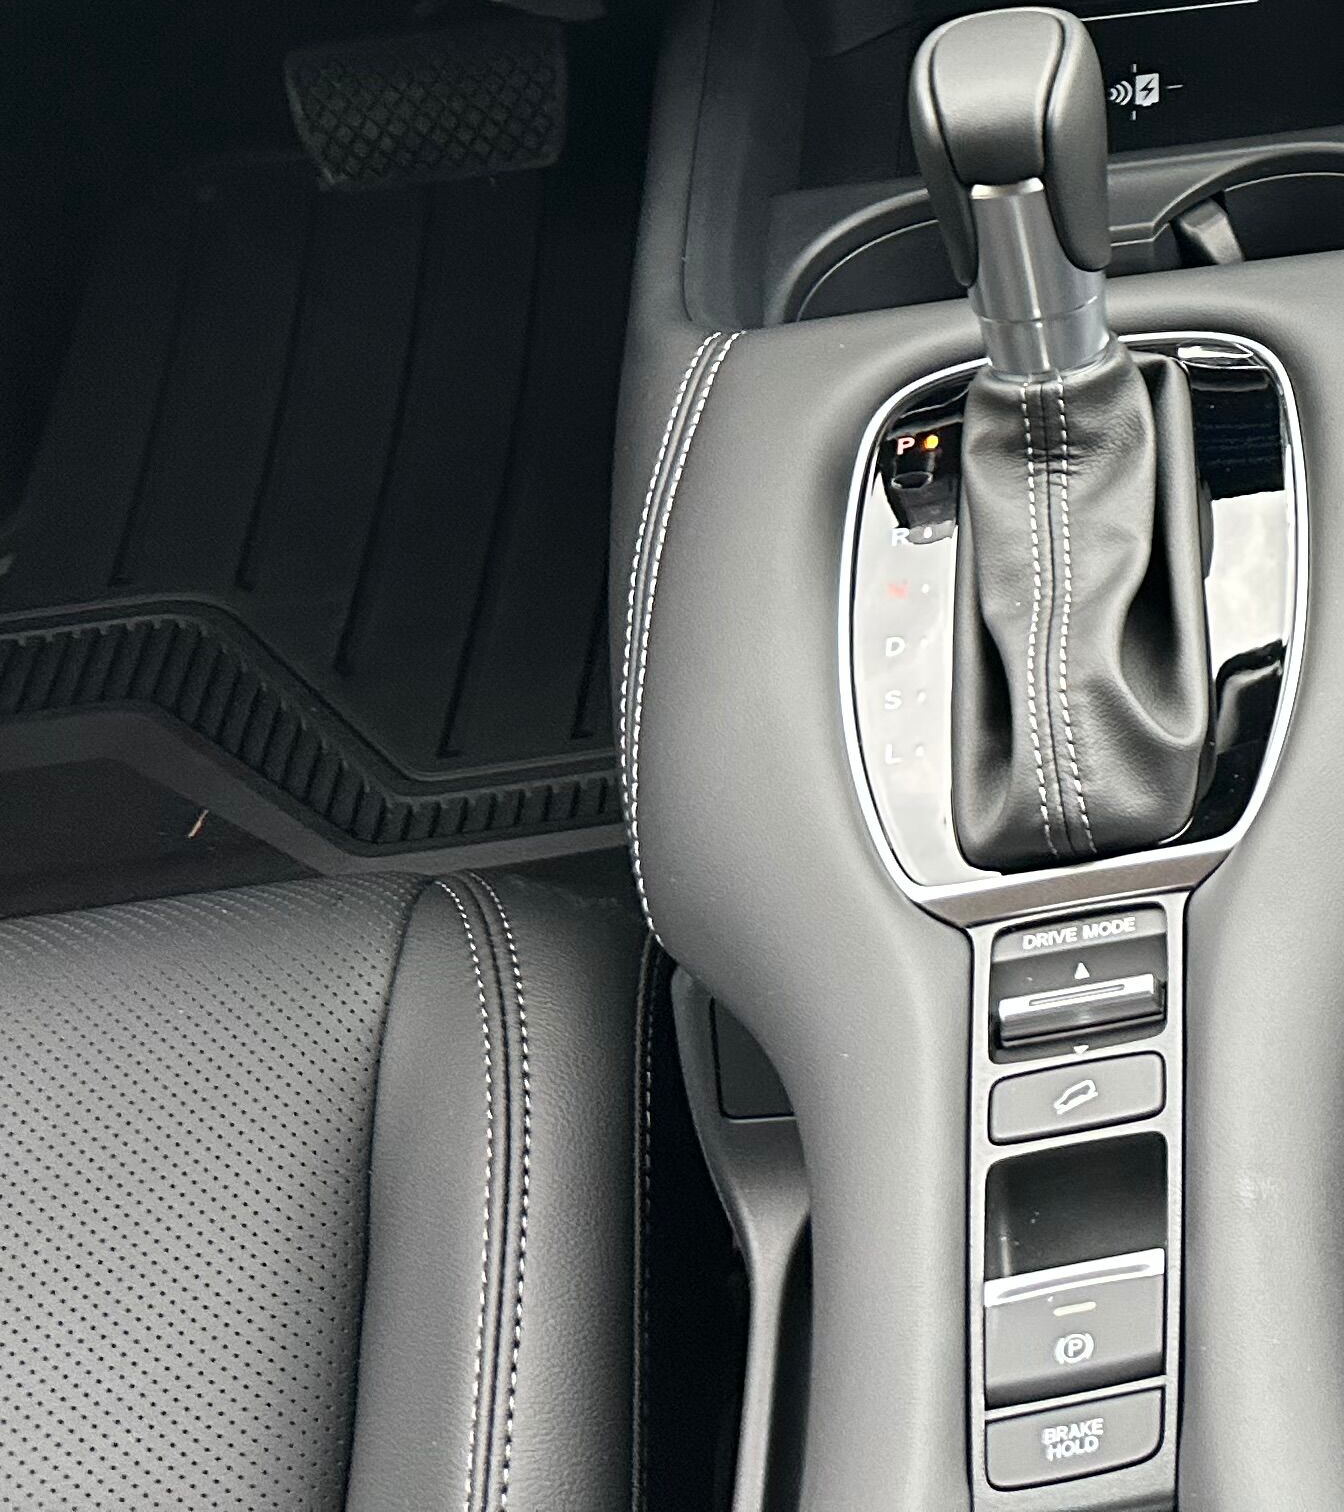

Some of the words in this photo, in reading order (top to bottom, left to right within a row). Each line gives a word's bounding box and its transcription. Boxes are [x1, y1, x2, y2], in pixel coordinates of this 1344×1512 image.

[897, 437, 915, 455] P
[891, 527, 911, 545] R
[885, 636, 905, 657] D
[884, 691, 902, 710] S
[884, 745, 902, 764] L
[1022, 927, 1078, 950] DRIVE
[1082, 917, 1136, 940] MODE
[1042, 1417, 1104, 1445] BRAKE
[1046, 1436, 1100, 1461] HOLD
